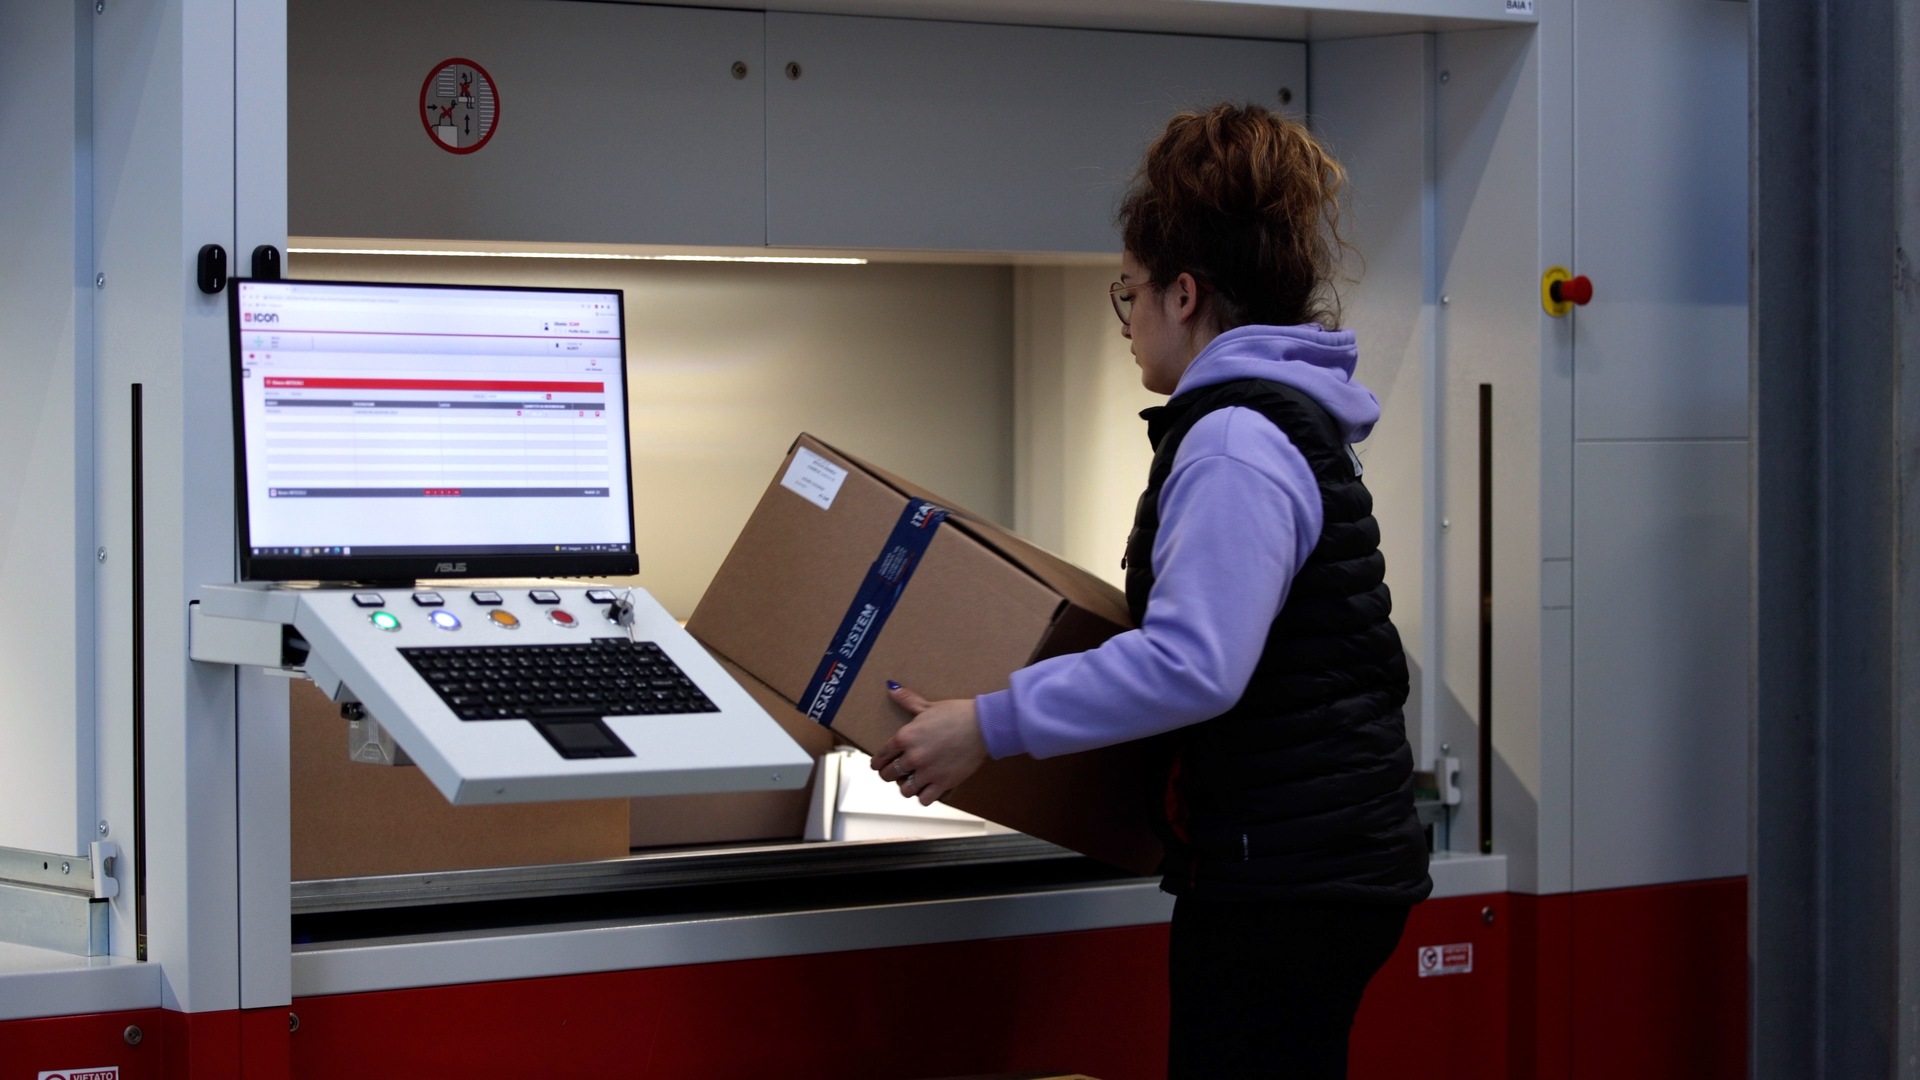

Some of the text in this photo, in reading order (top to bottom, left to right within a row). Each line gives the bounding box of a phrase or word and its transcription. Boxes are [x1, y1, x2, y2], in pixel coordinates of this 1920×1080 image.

[1506, 0, 1526, 9] BAIA
[435, 562, 467, 573] ASUS
[839, 603, 877, 657] SYSTEM
[73, 1072, 114, 1080] VIETATO
